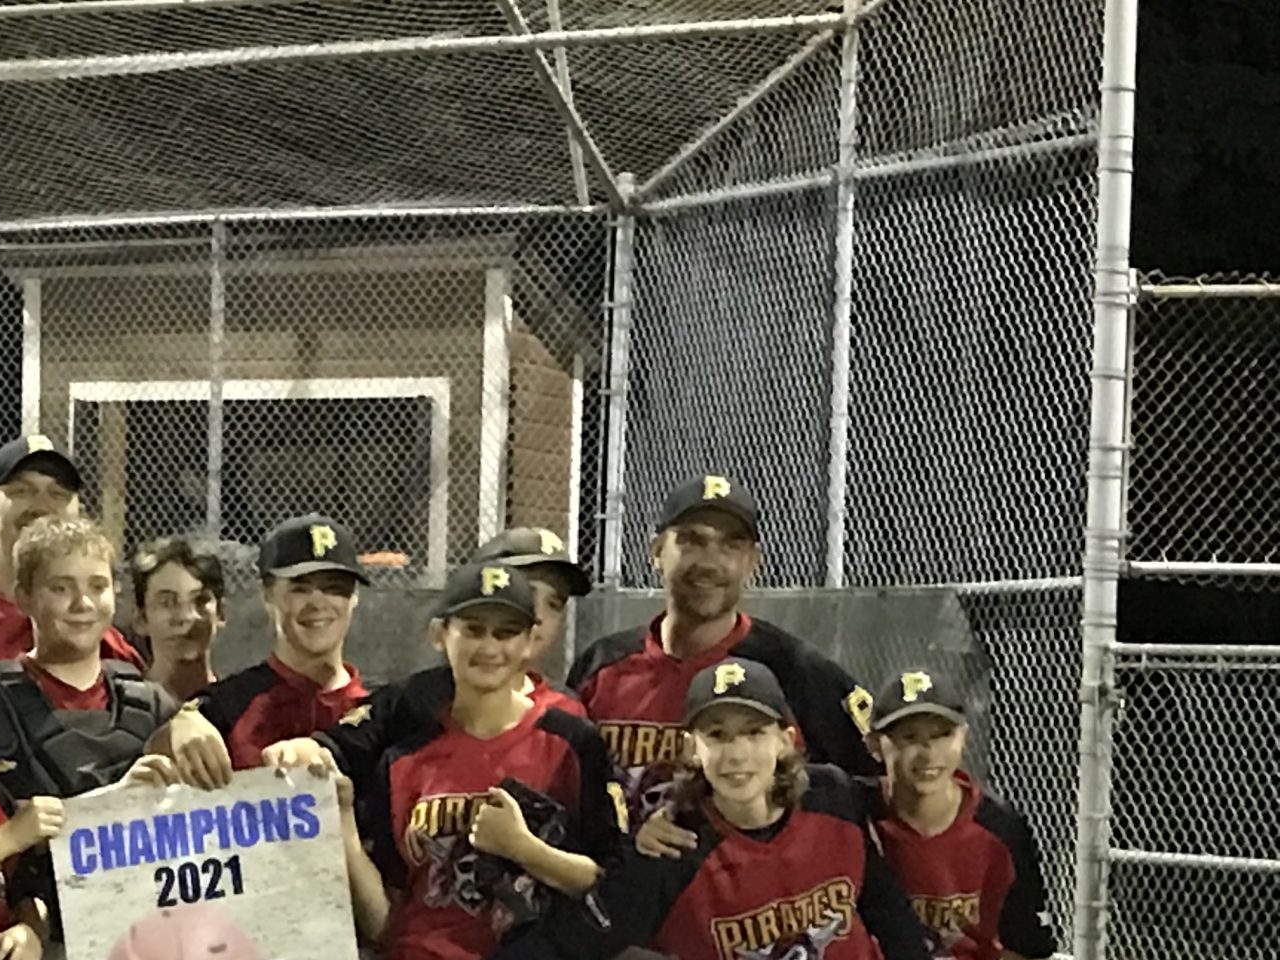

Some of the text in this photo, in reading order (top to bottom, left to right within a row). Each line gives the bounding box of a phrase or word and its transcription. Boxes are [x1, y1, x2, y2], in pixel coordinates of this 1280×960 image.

[703, 475, 731, 500] P
[310, 525, 337, 557] P
[482, 567, 510, 595] P
[713, 663, 745, 694] P
[901, 671, 933, 702] P
[70, 793, 320, 876] CHAMPIONS
[155, 855, 245, 907] 2021
